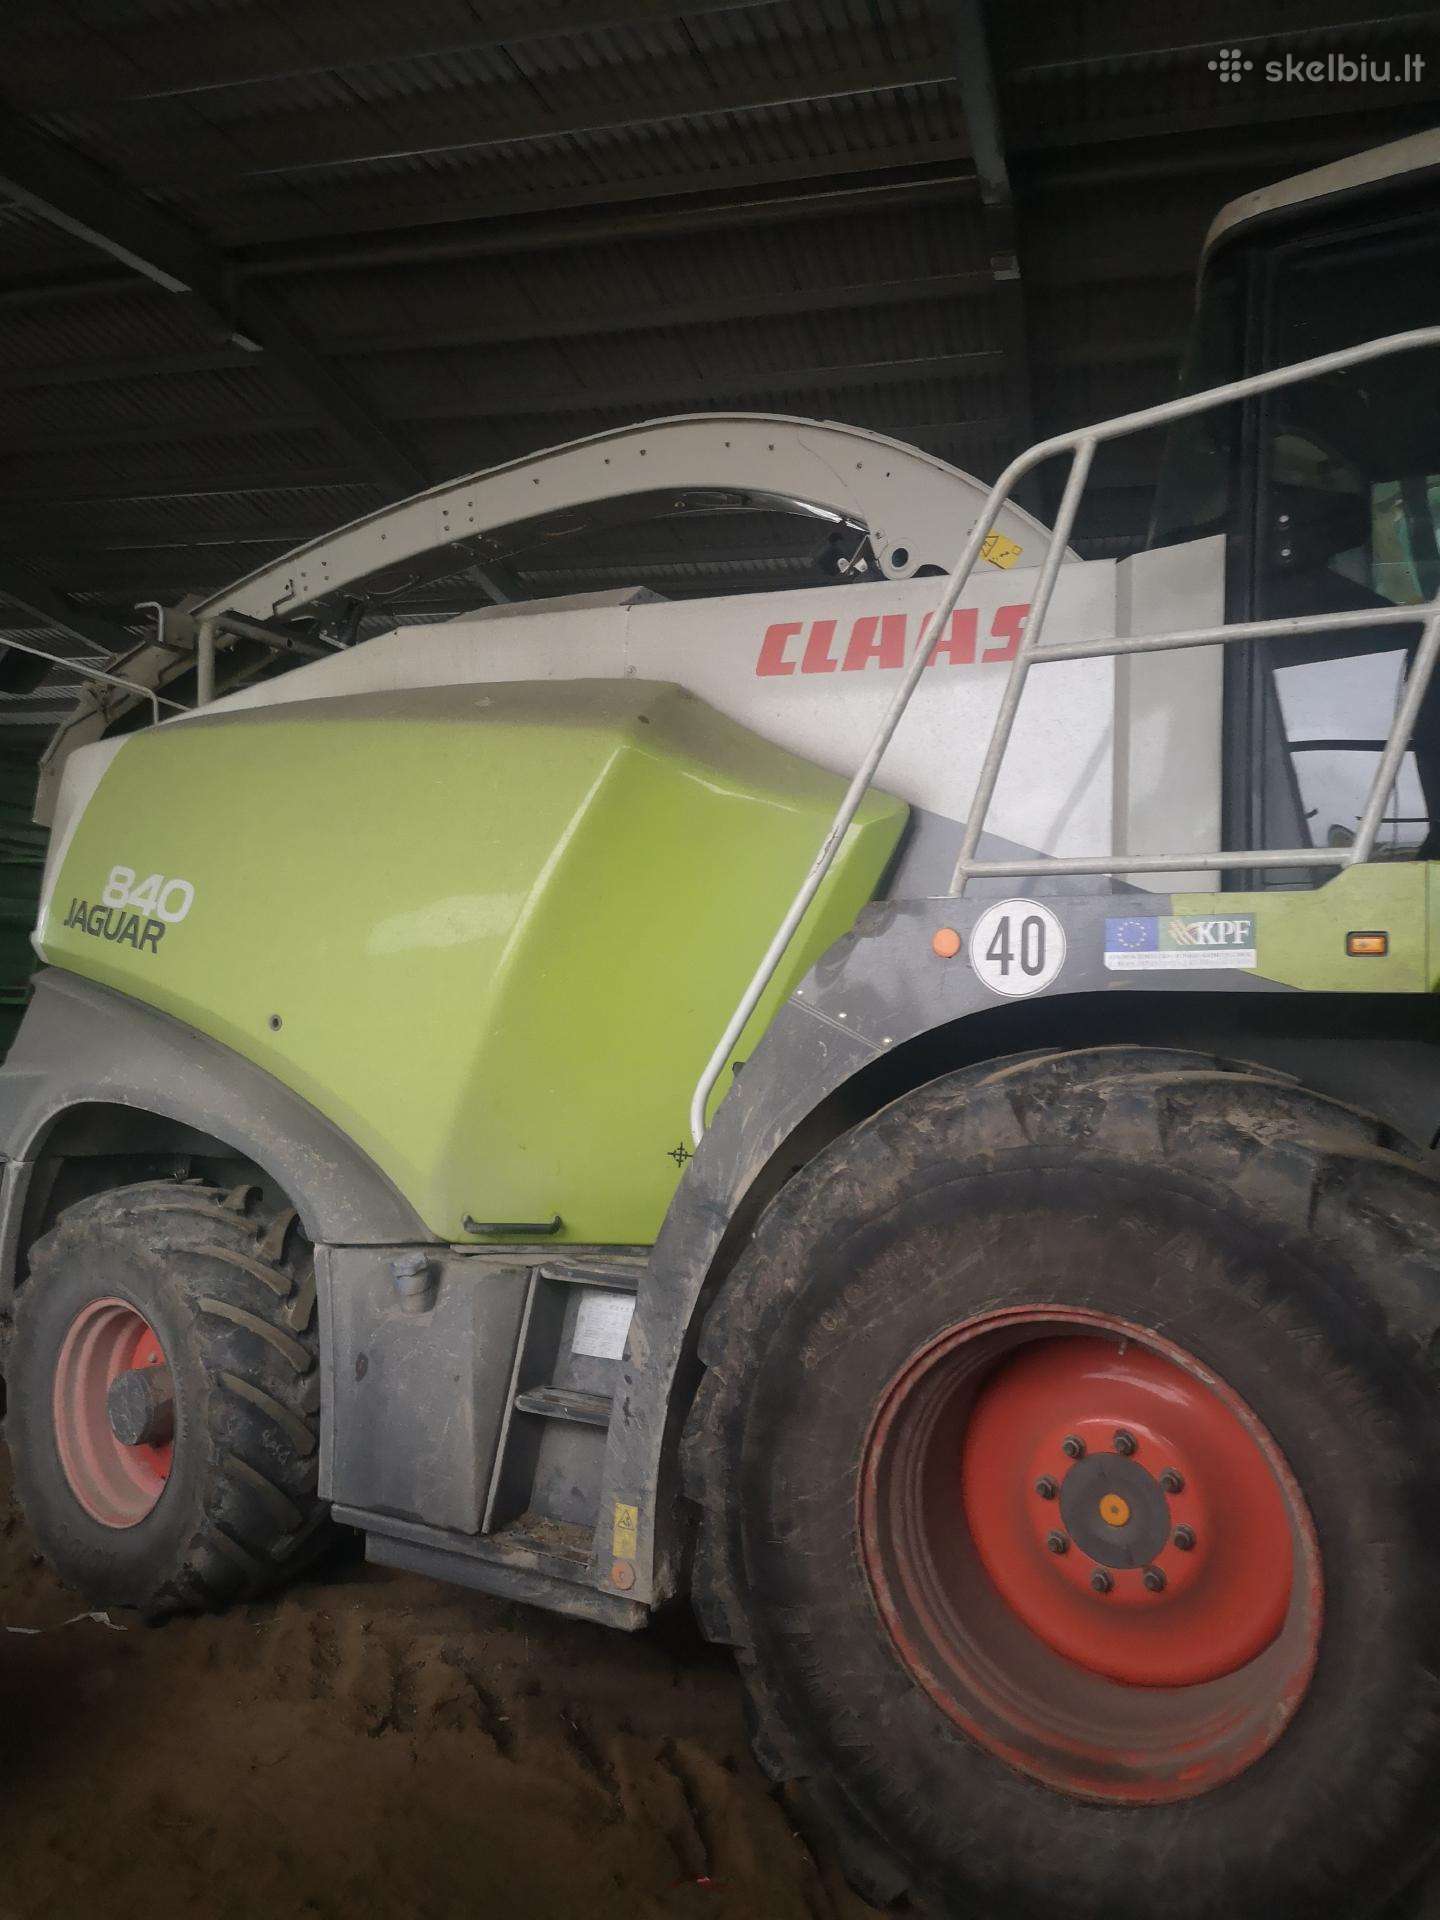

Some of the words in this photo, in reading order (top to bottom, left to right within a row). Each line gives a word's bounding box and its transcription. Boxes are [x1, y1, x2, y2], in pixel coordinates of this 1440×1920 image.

[755, 603, 1033, 677] CLAAS
[101, 864, 195, 924] 840
[63, 898, 166, 954] JAGUAR
[985, 915, 1047, 977] 40
[1196, 920, 1251, 945] KPF
